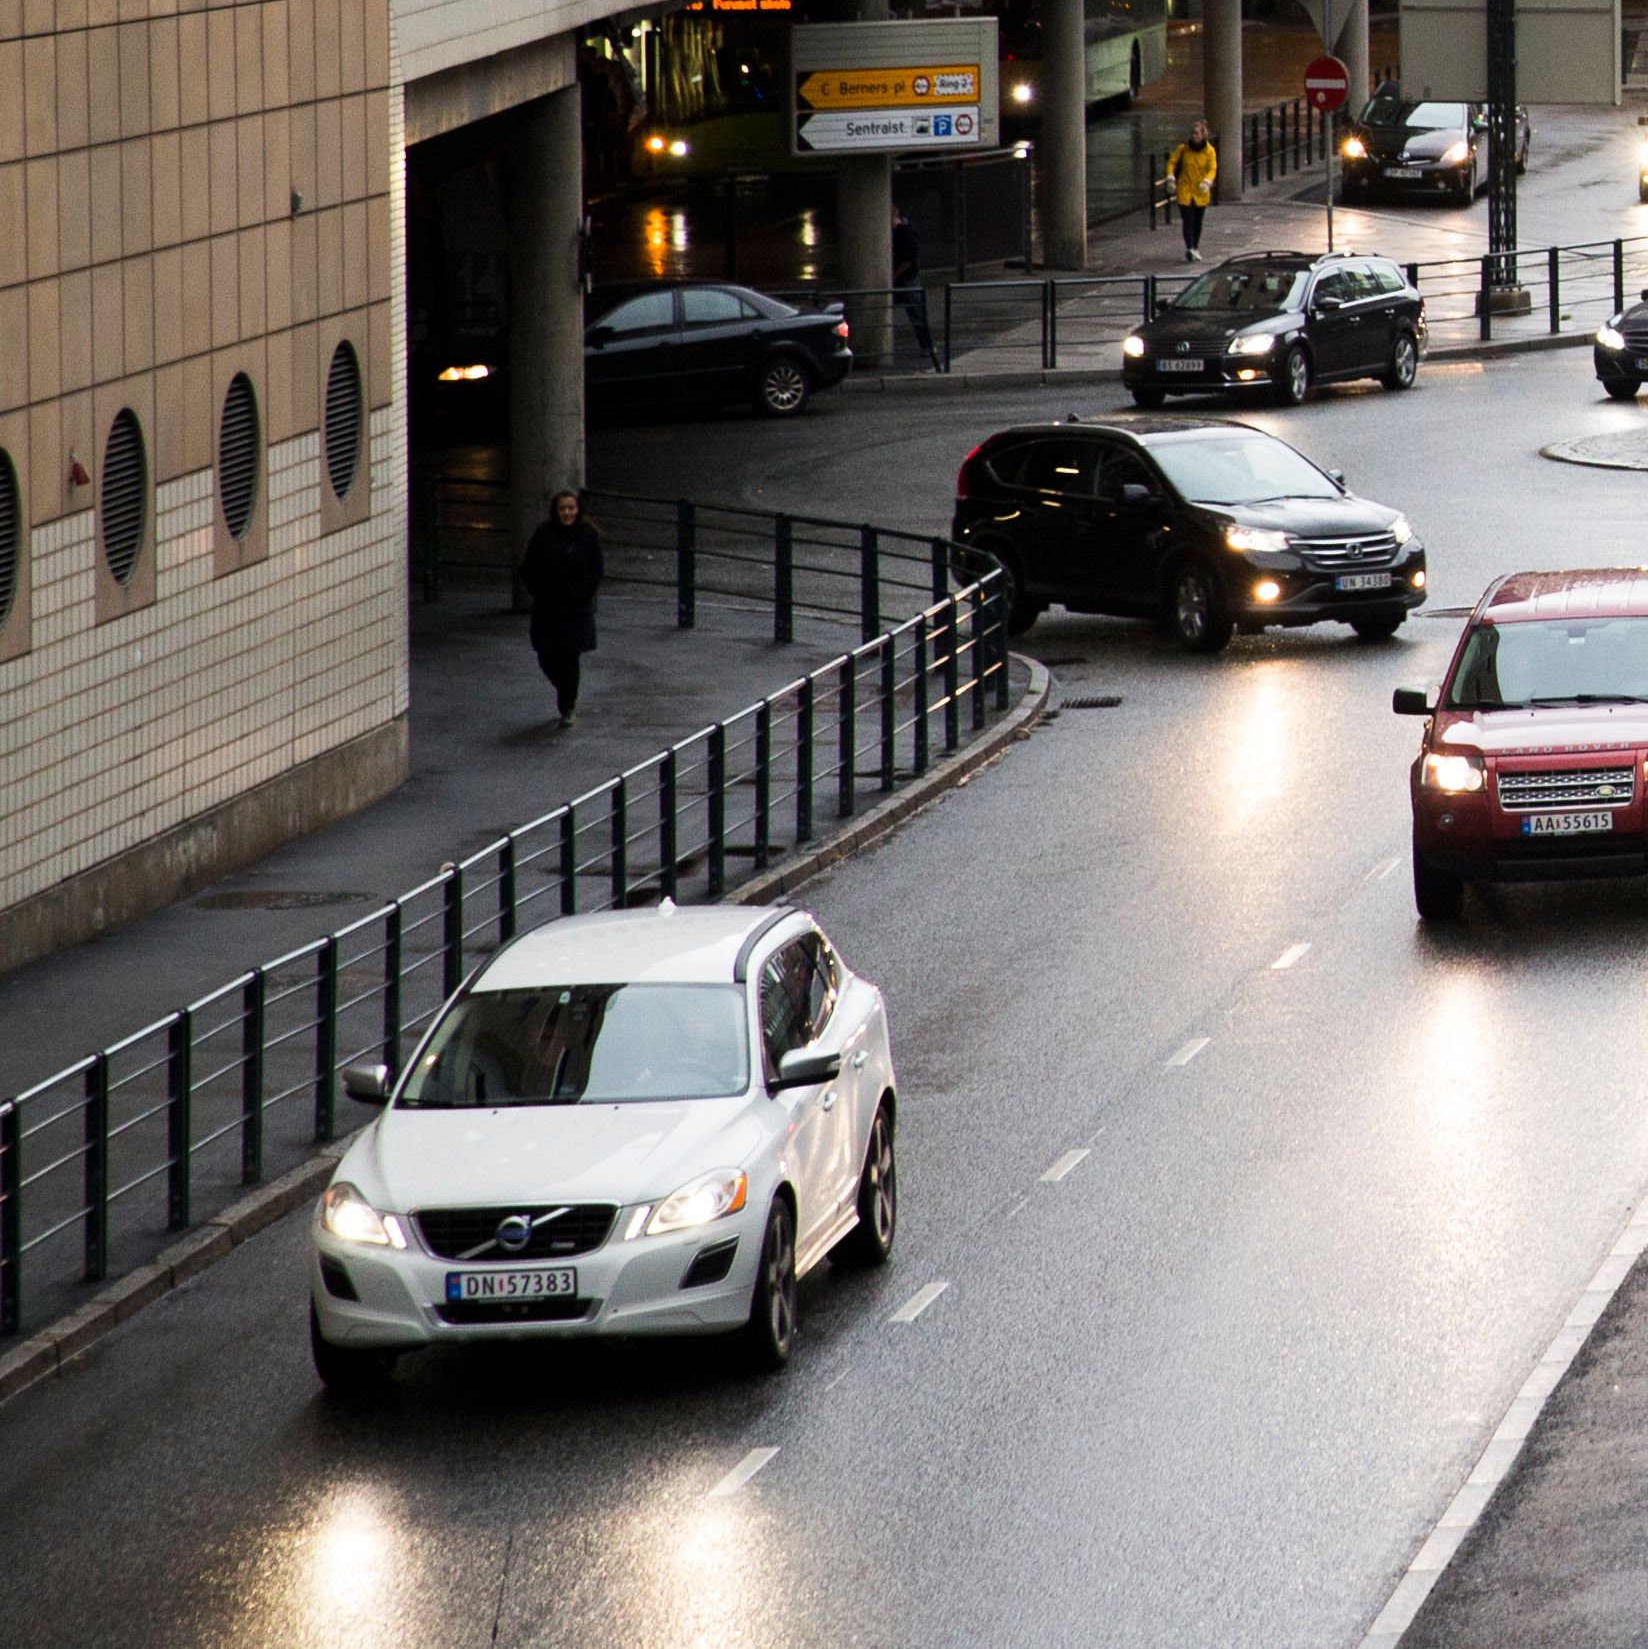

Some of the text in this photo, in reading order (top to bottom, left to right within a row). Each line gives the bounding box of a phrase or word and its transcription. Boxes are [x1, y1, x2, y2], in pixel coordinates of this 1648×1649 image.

[839, 81, 888, 96] Berners
[1502, 743, 1630, 754] LAND ROVER
[1534, 813, 1609, 832] AA 55615
[466, 1272, 571, 1296] DN 57383
